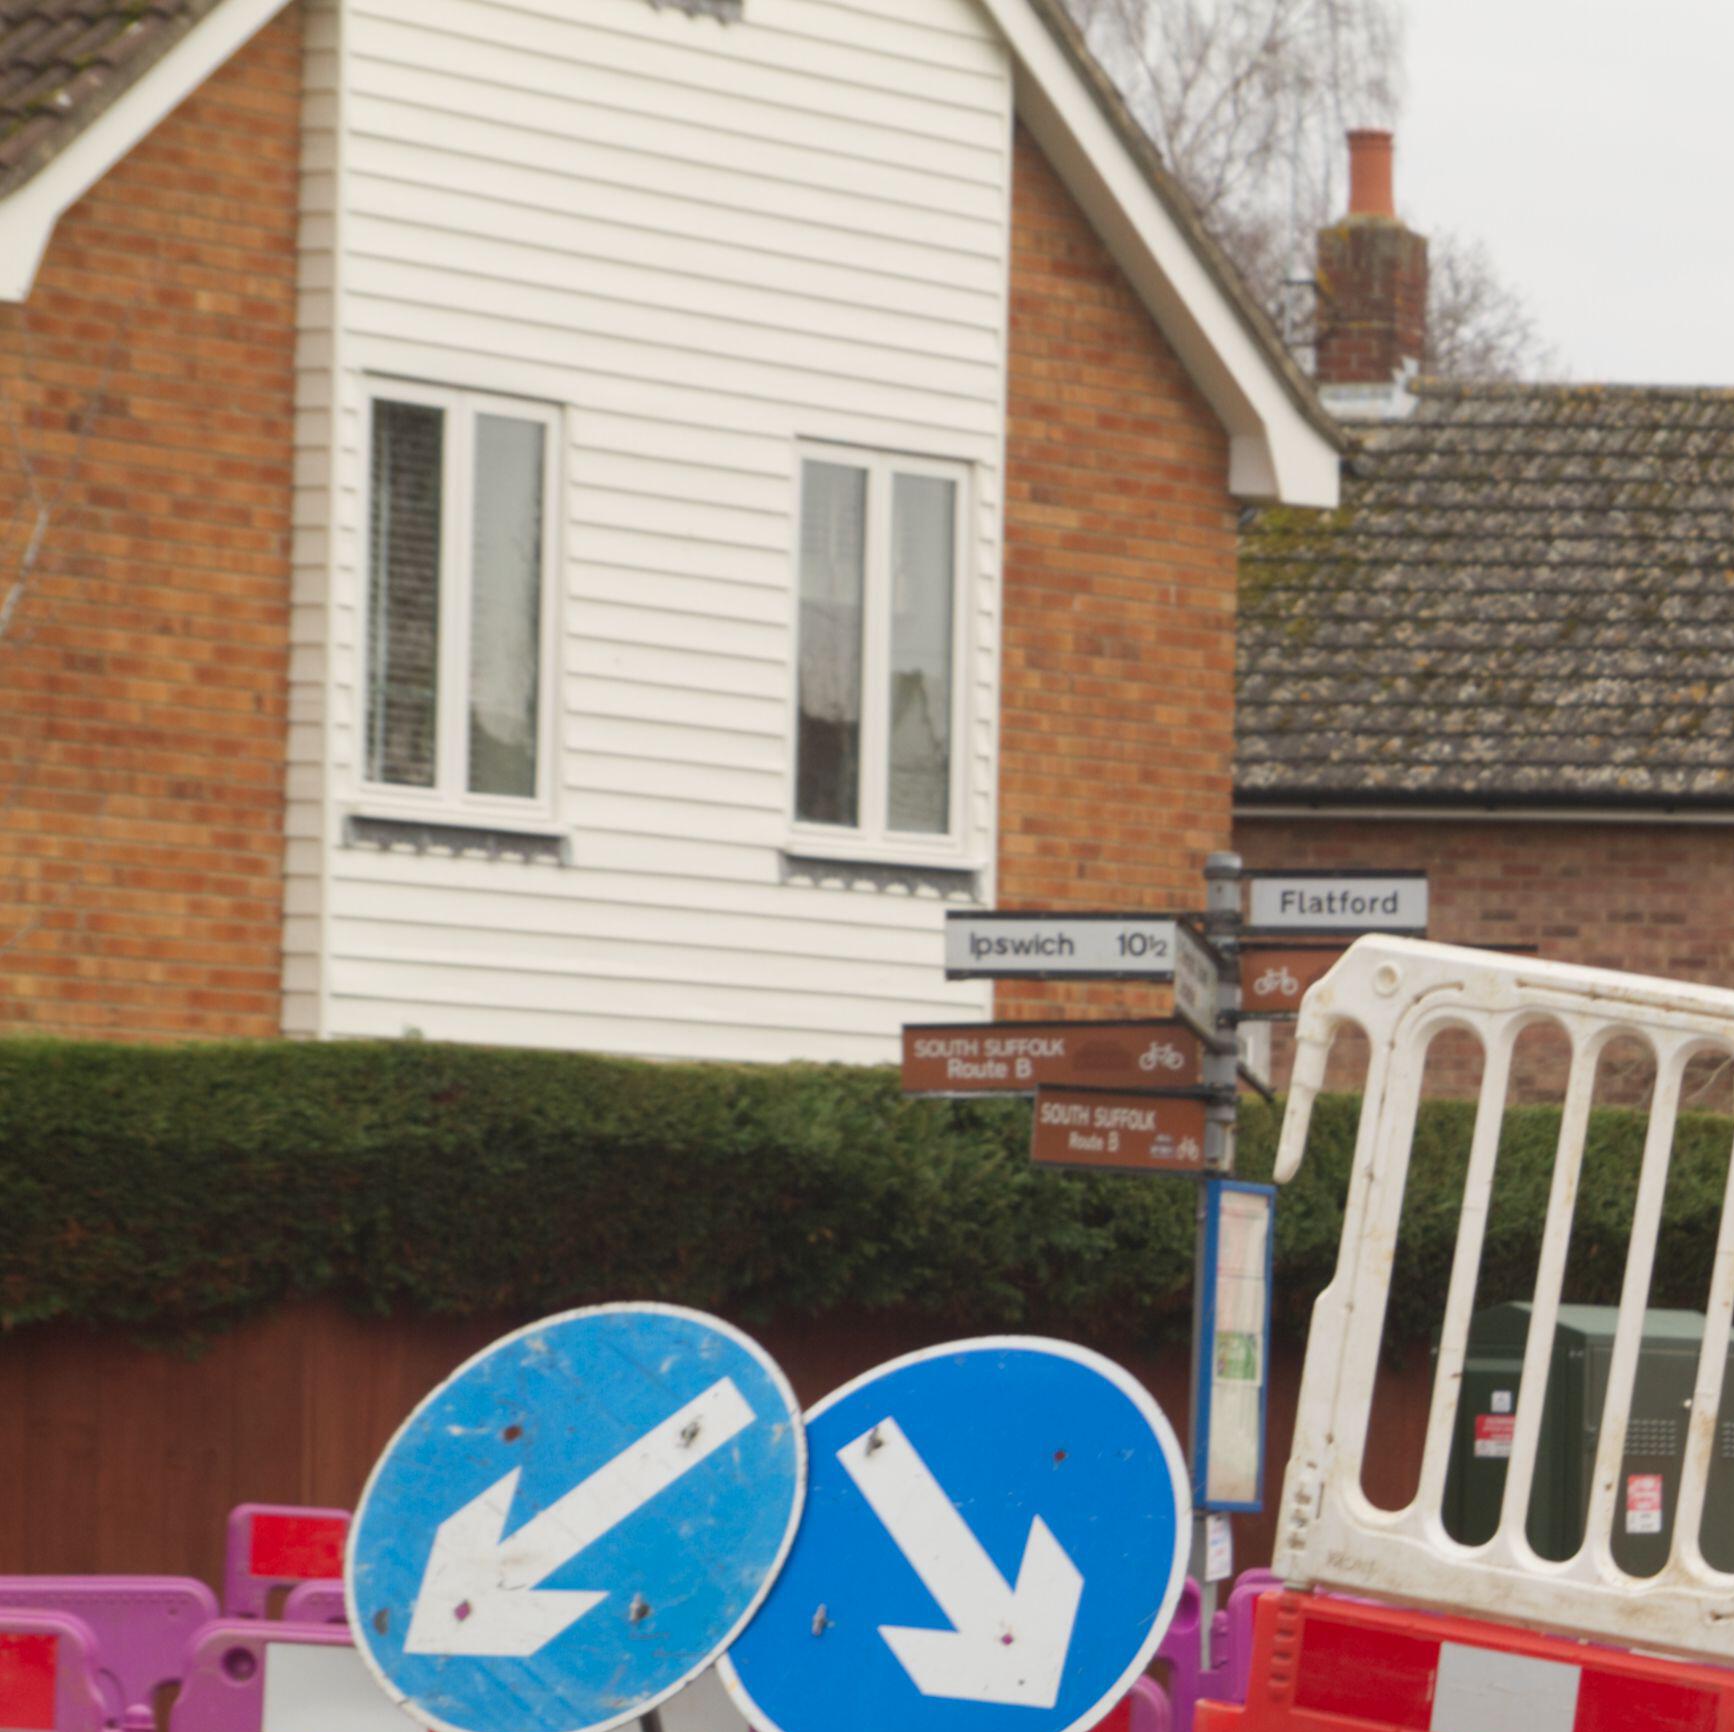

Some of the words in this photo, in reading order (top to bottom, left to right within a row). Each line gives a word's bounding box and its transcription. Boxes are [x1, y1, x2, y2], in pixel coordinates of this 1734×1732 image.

[1280, 890, 1398, 914] Flatford
[968, 931, 1075, 961] Ipswich
[913, 1038, 978, 1058] SOUTH
[983, 1037, 1065, 1057] SUFFOLK
[947, 1058, 1009, 1079] Route
[1040, 1103, 1090, 1126] SOUTH
[1094, 1106, 1157, 1131] SUFFOLK
[1068, 1131, 1105, 1152] Route
